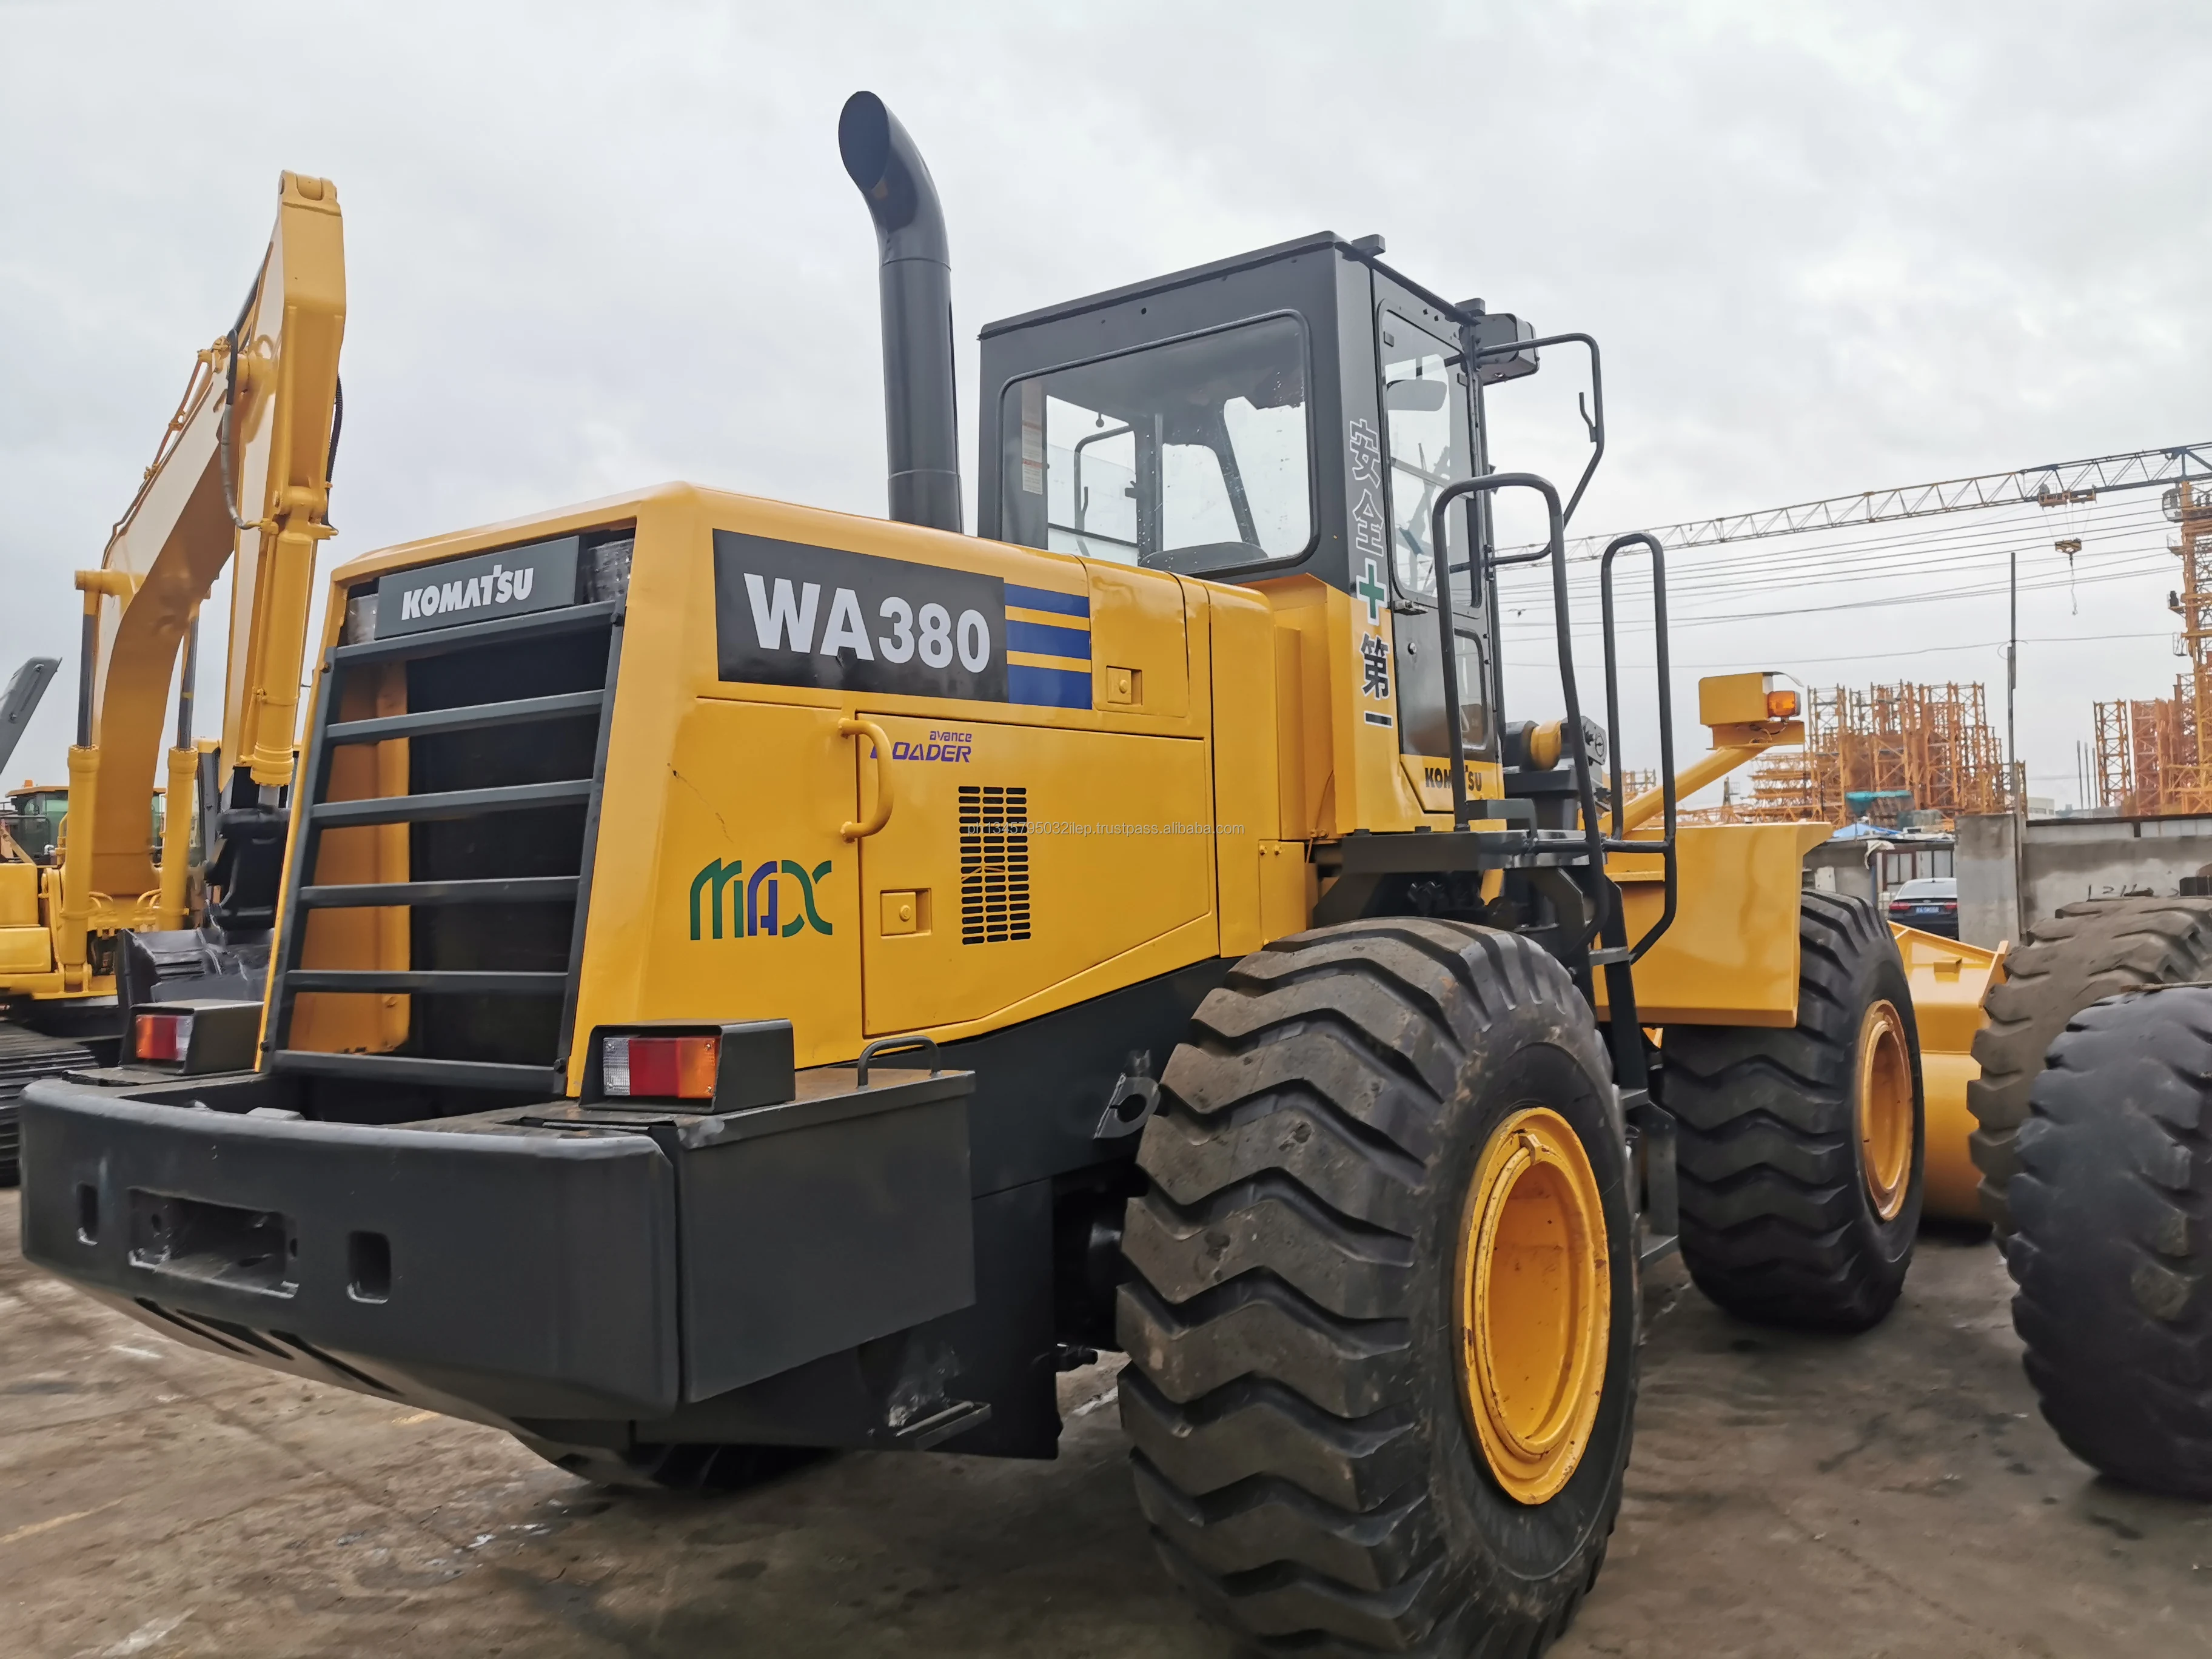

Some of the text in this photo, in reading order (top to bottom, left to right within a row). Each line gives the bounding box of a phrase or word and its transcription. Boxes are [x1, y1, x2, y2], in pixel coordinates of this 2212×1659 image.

[401, 564, 534, 620] KOMATSU
[1349, 418, 1393, 728] 安全 第一
[743, 572, 990, 673] WA380
[930, 730, 972, 742] avance
[1425, 765, 1482, 791] KOMSU
[689, 857, 833, 940] MAX
